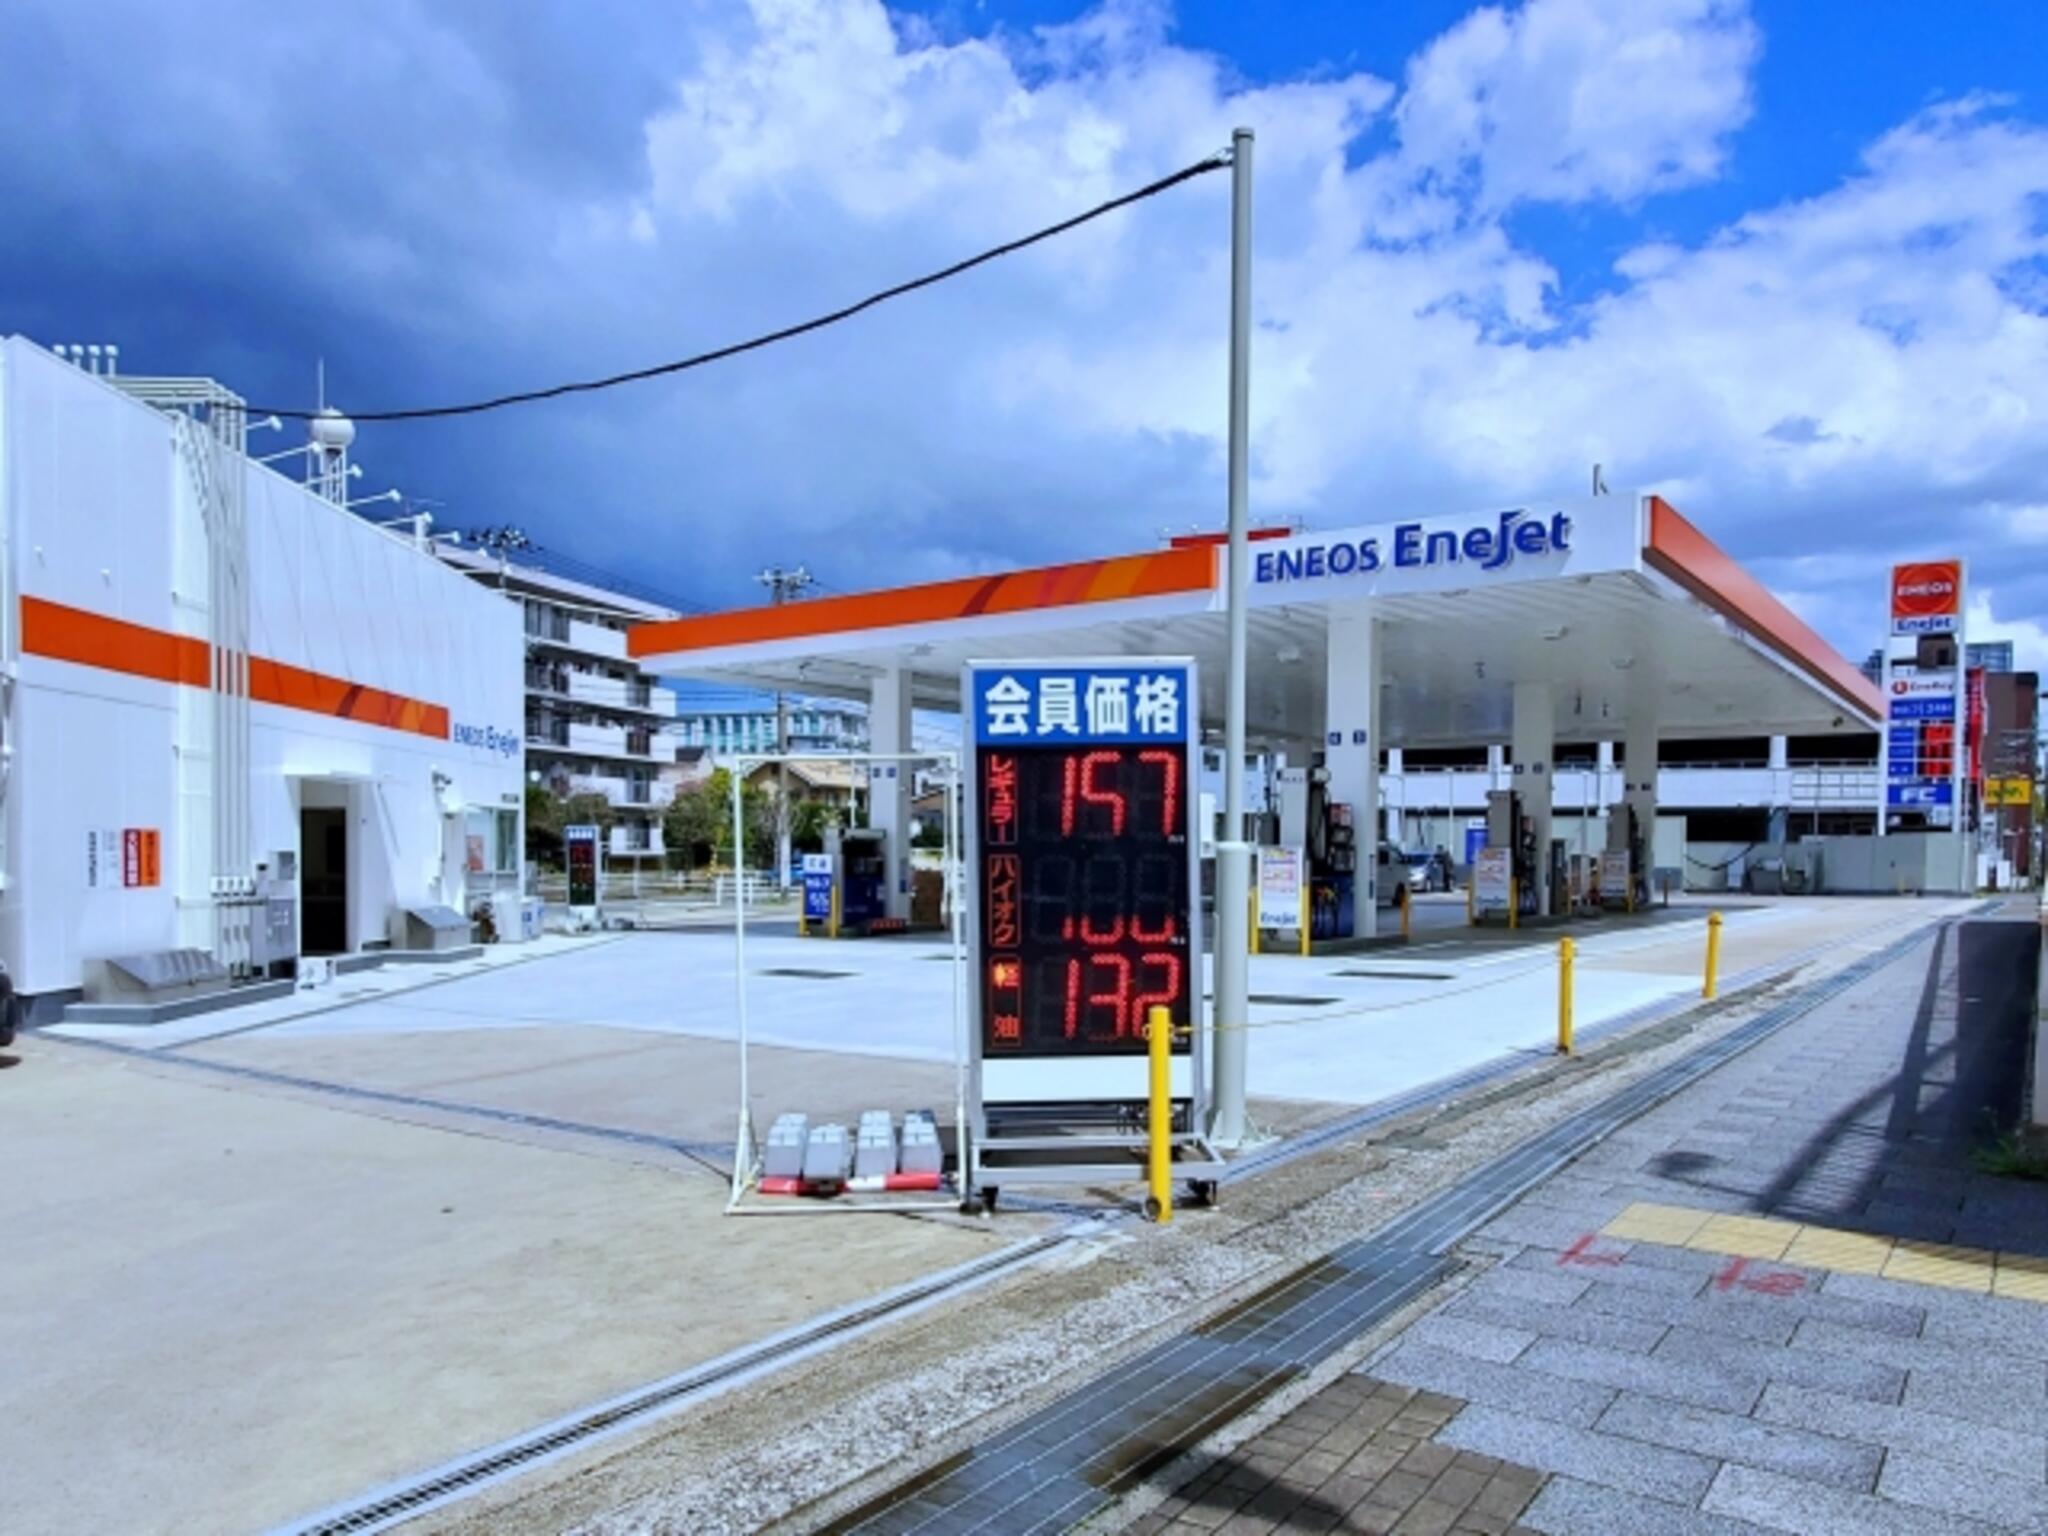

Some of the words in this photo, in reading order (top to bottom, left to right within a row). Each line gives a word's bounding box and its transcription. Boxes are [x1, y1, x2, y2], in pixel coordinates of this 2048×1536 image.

[1255, 538, 1380, 583] ENEOS
[984, 675, 1179, 736] 会員価格
[988, 753, 1015, 844] レギュラー
[1060, 750, 1178, 837] 157
[990, 857, 1016, 945] ハイオク
[1063, 952, 1180, 1041] 132
